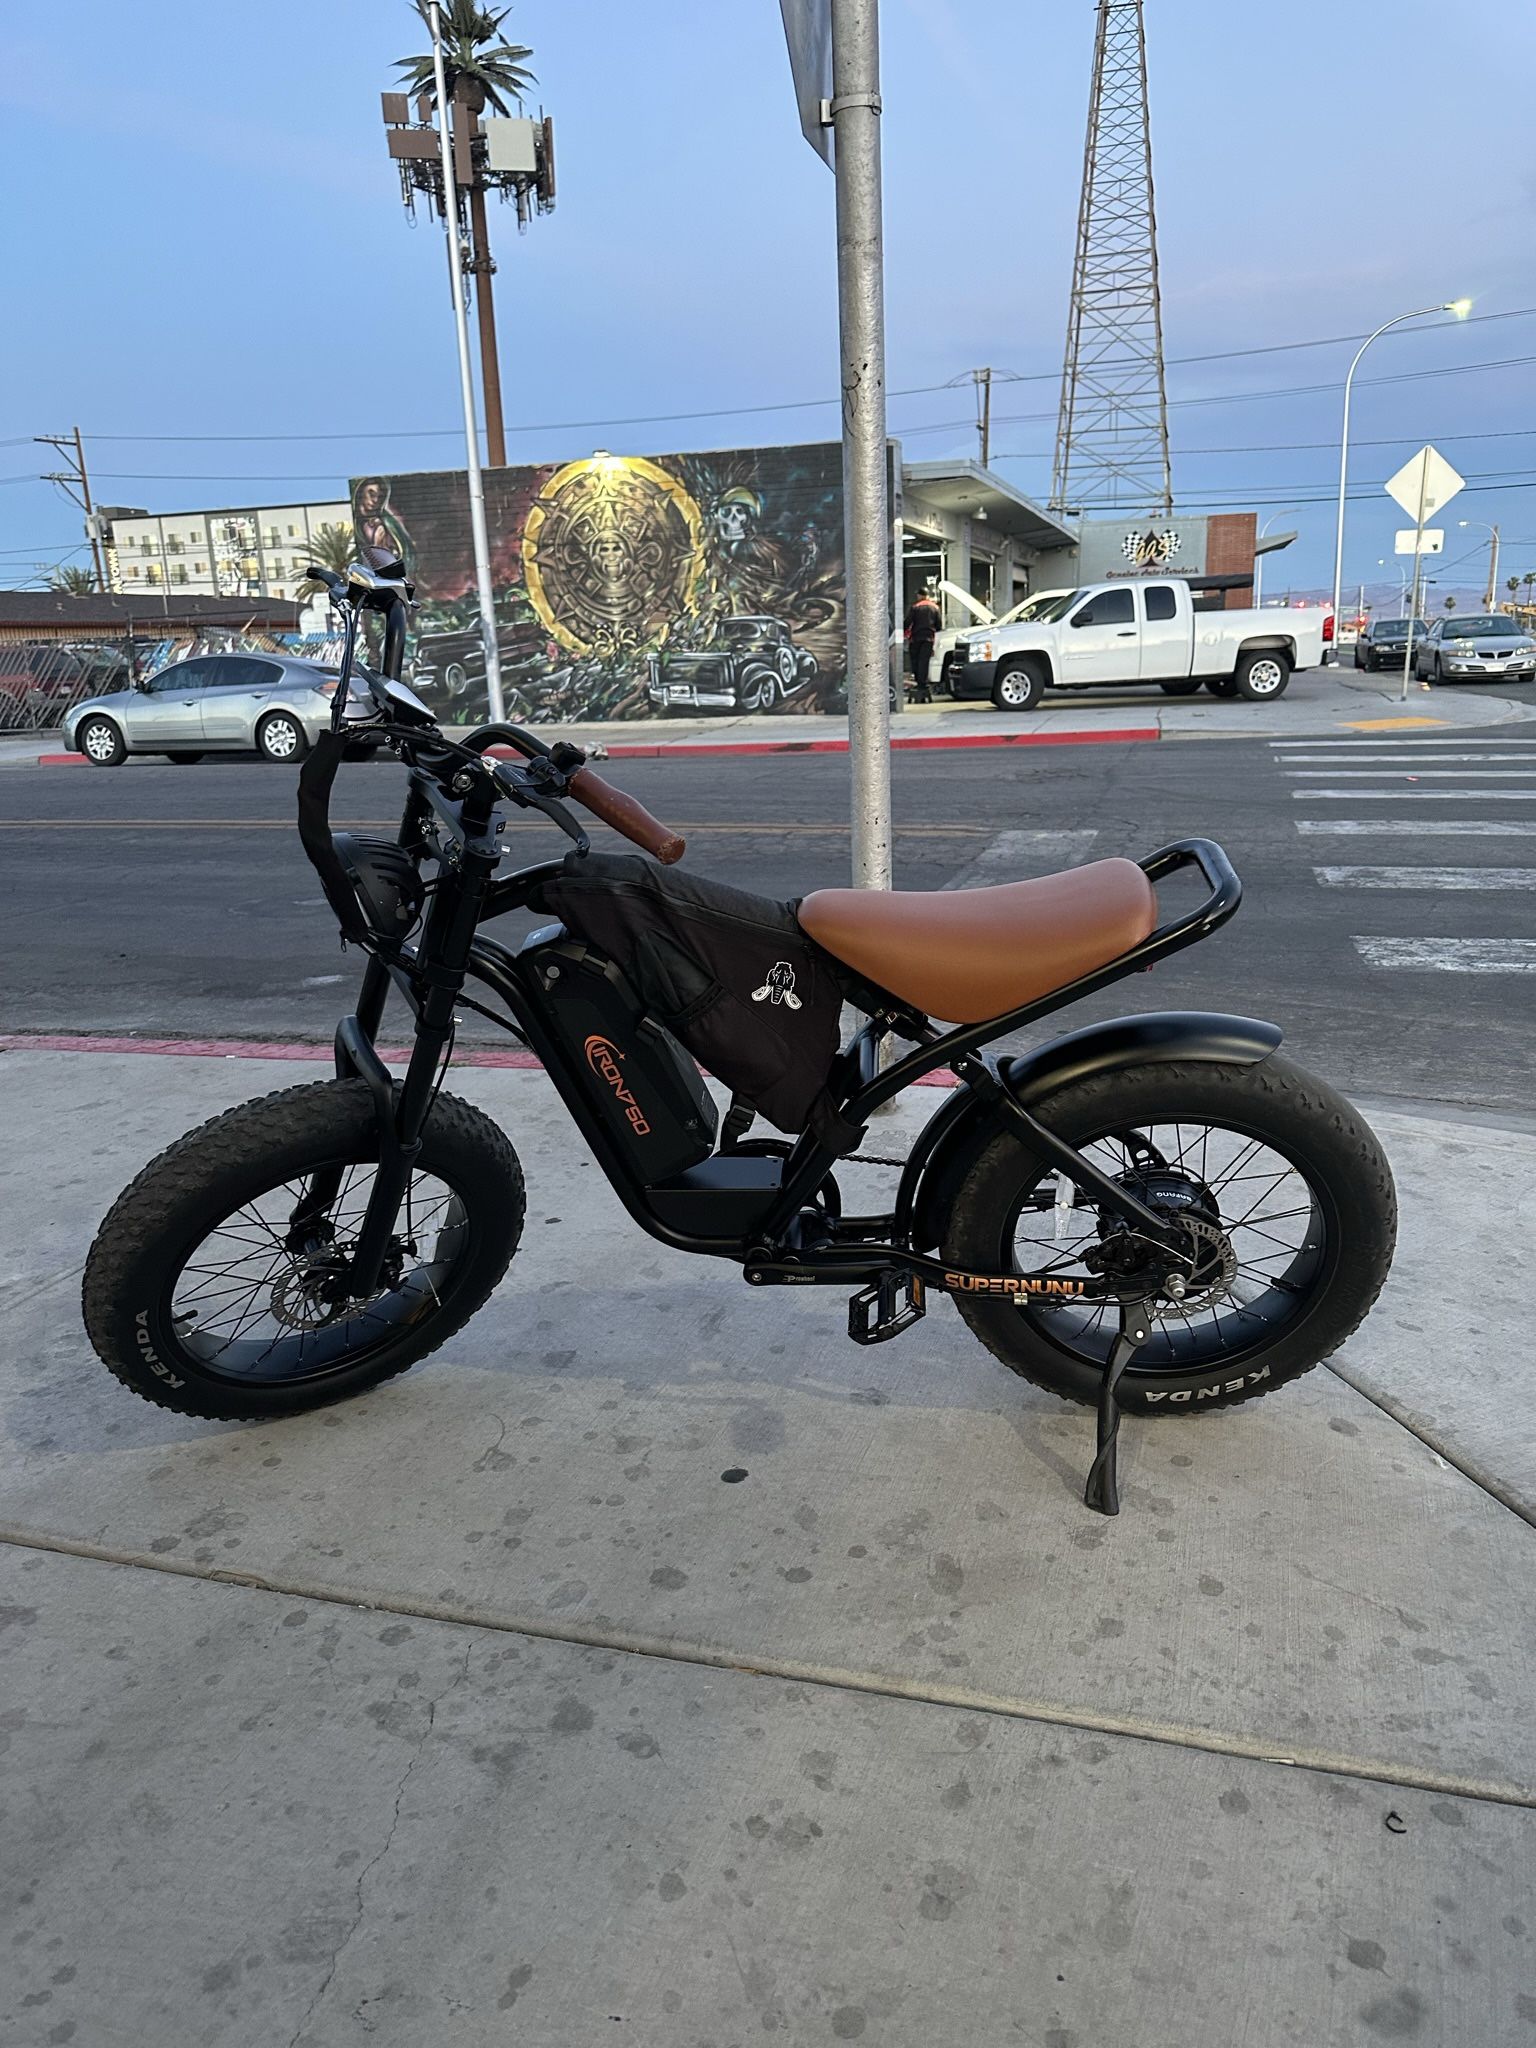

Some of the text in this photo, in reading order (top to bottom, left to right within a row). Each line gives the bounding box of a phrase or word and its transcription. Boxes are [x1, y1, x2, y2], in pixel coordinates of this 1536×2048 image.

[592, 1045, 650, 1136] IRON750
[945, 1273, 1084, 1295] SUPERNUNU
[136, 1309, 186, 1389] KENDA
[1145, 1365, 1271, 1402] KENDA
